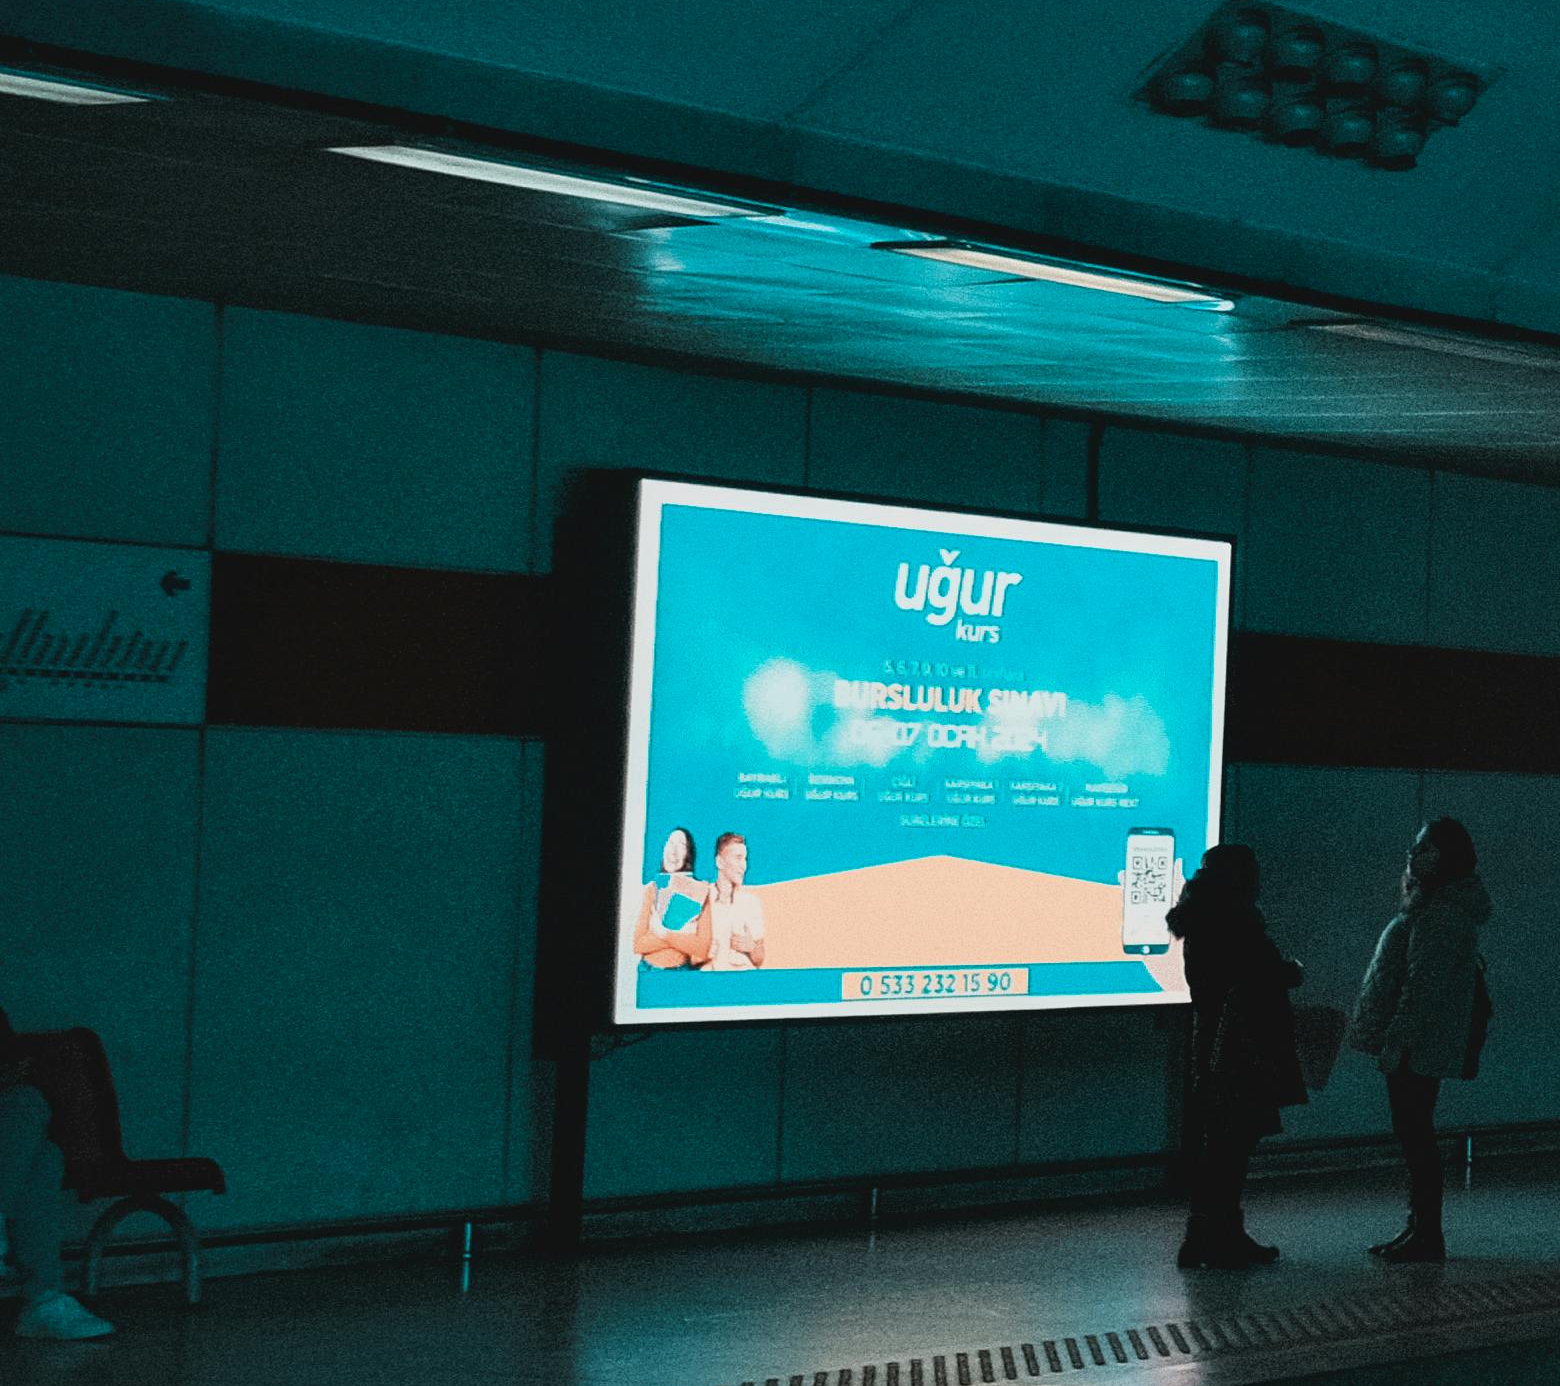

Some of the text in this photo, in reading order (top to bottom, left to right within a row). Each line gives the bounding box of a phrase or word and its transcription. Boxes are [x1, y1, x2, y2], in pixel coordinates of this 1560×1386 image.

[895, 548, 1023, 626] uğur
[955, 618, 1001, 644] kurs
[860, 971, 1011, 995] 0 533 232 15 90
